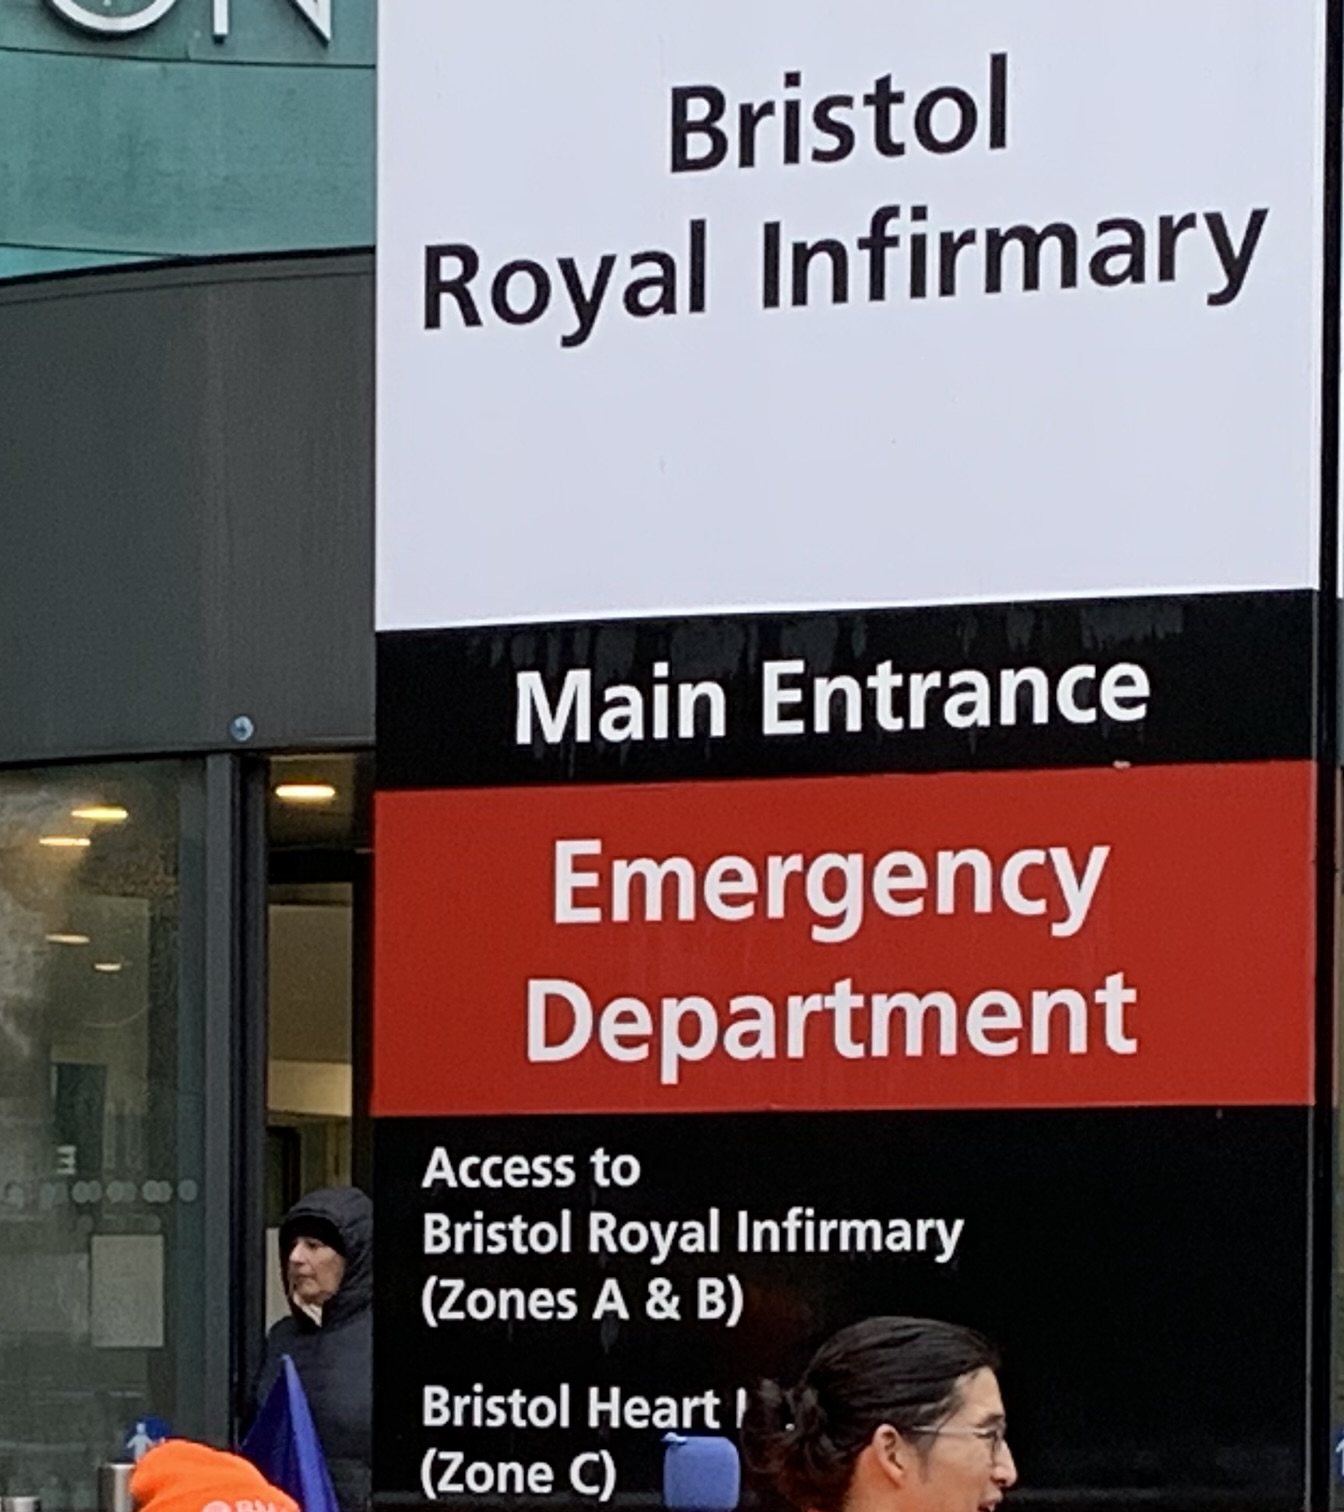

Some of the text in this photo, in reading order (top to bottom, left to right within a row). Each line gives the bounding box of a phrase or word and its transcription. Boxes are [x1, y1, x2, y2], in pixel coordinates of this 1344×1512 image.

[671, 53, 1007, 172] Bristol
[424, 205, 1268, 347] Royal Infirmary
[516, 660, 1150, 745] Main Entrance
[554, 840, 1111, 942] Emergency
[527, 971, 1137, 1084] Department
[421, 1146, 641, 1188] Access to
[424, 1206, 965, 1264] Bristol Royal Infirmary
[422, 1274, 744, 1327] (Zones A & B)
[423, 1382, 570, 1428] Bristol
[588, 1386, 721, 1429] Heart
[421, 1447, 616, 1502] (Zone C)
